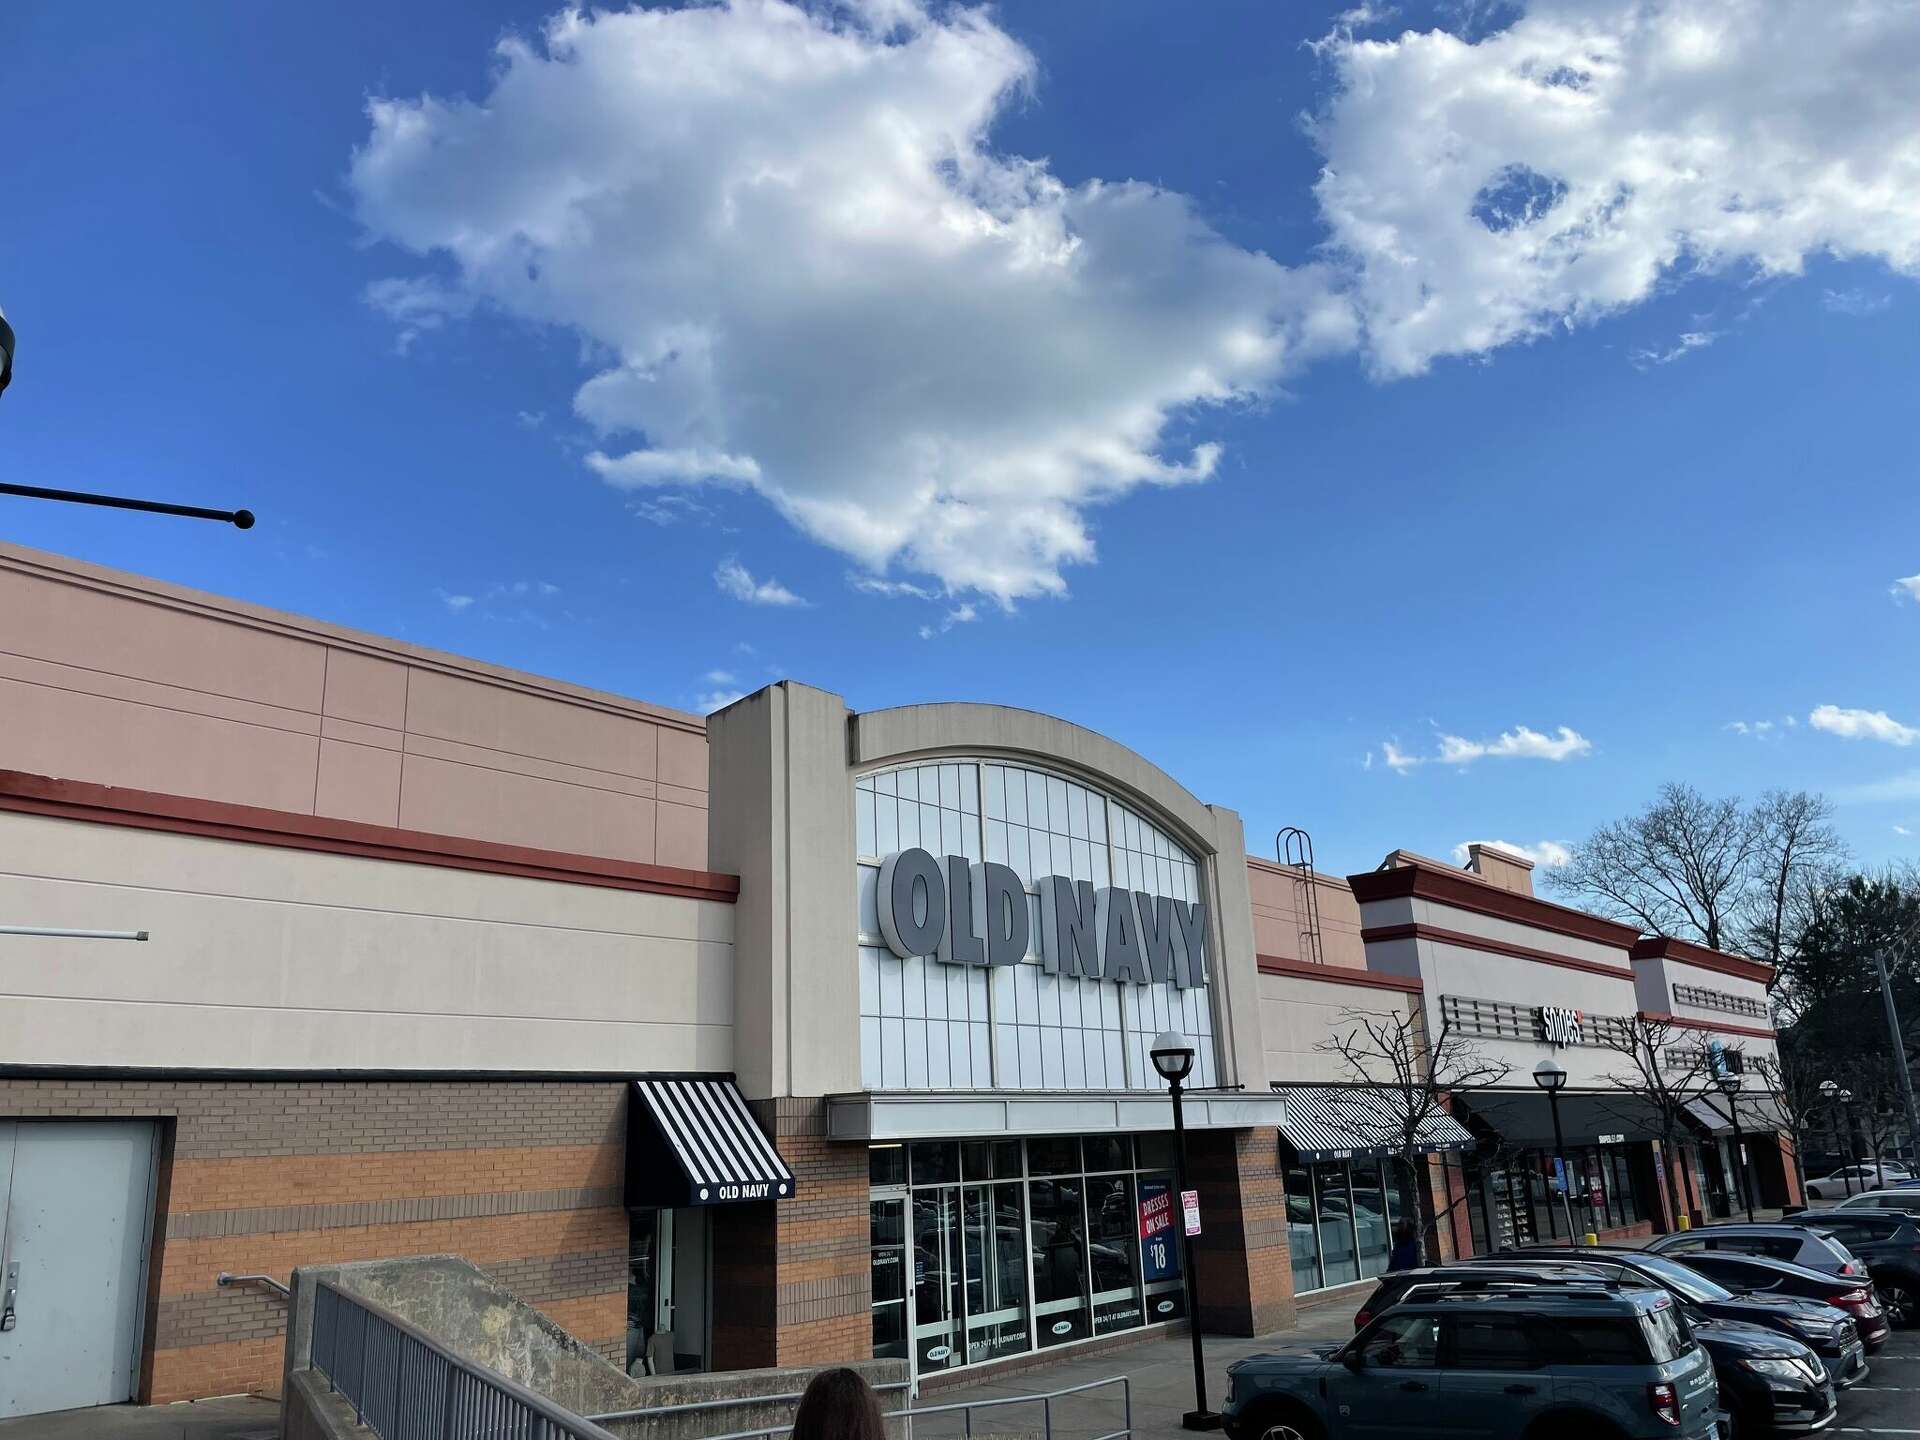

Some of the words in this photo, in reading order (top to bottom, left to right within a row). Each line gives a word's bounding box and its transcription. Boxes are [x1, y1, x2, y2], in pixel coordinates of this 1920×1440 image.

[878, 848, 1029, 966] OLD
[1041, 874, 1207, 989] NAVY
[719, 1186, 739, 1200] OLD
[742, 1183, 769, 1198] NAVY
[1143, 1193, 1169, 1216] DRESSES
[1146, 1218, 1156, 1234] ON
[1155, 1212, 1169, 1230] SALE
[1150, 1243, 1166, 1270] $18
